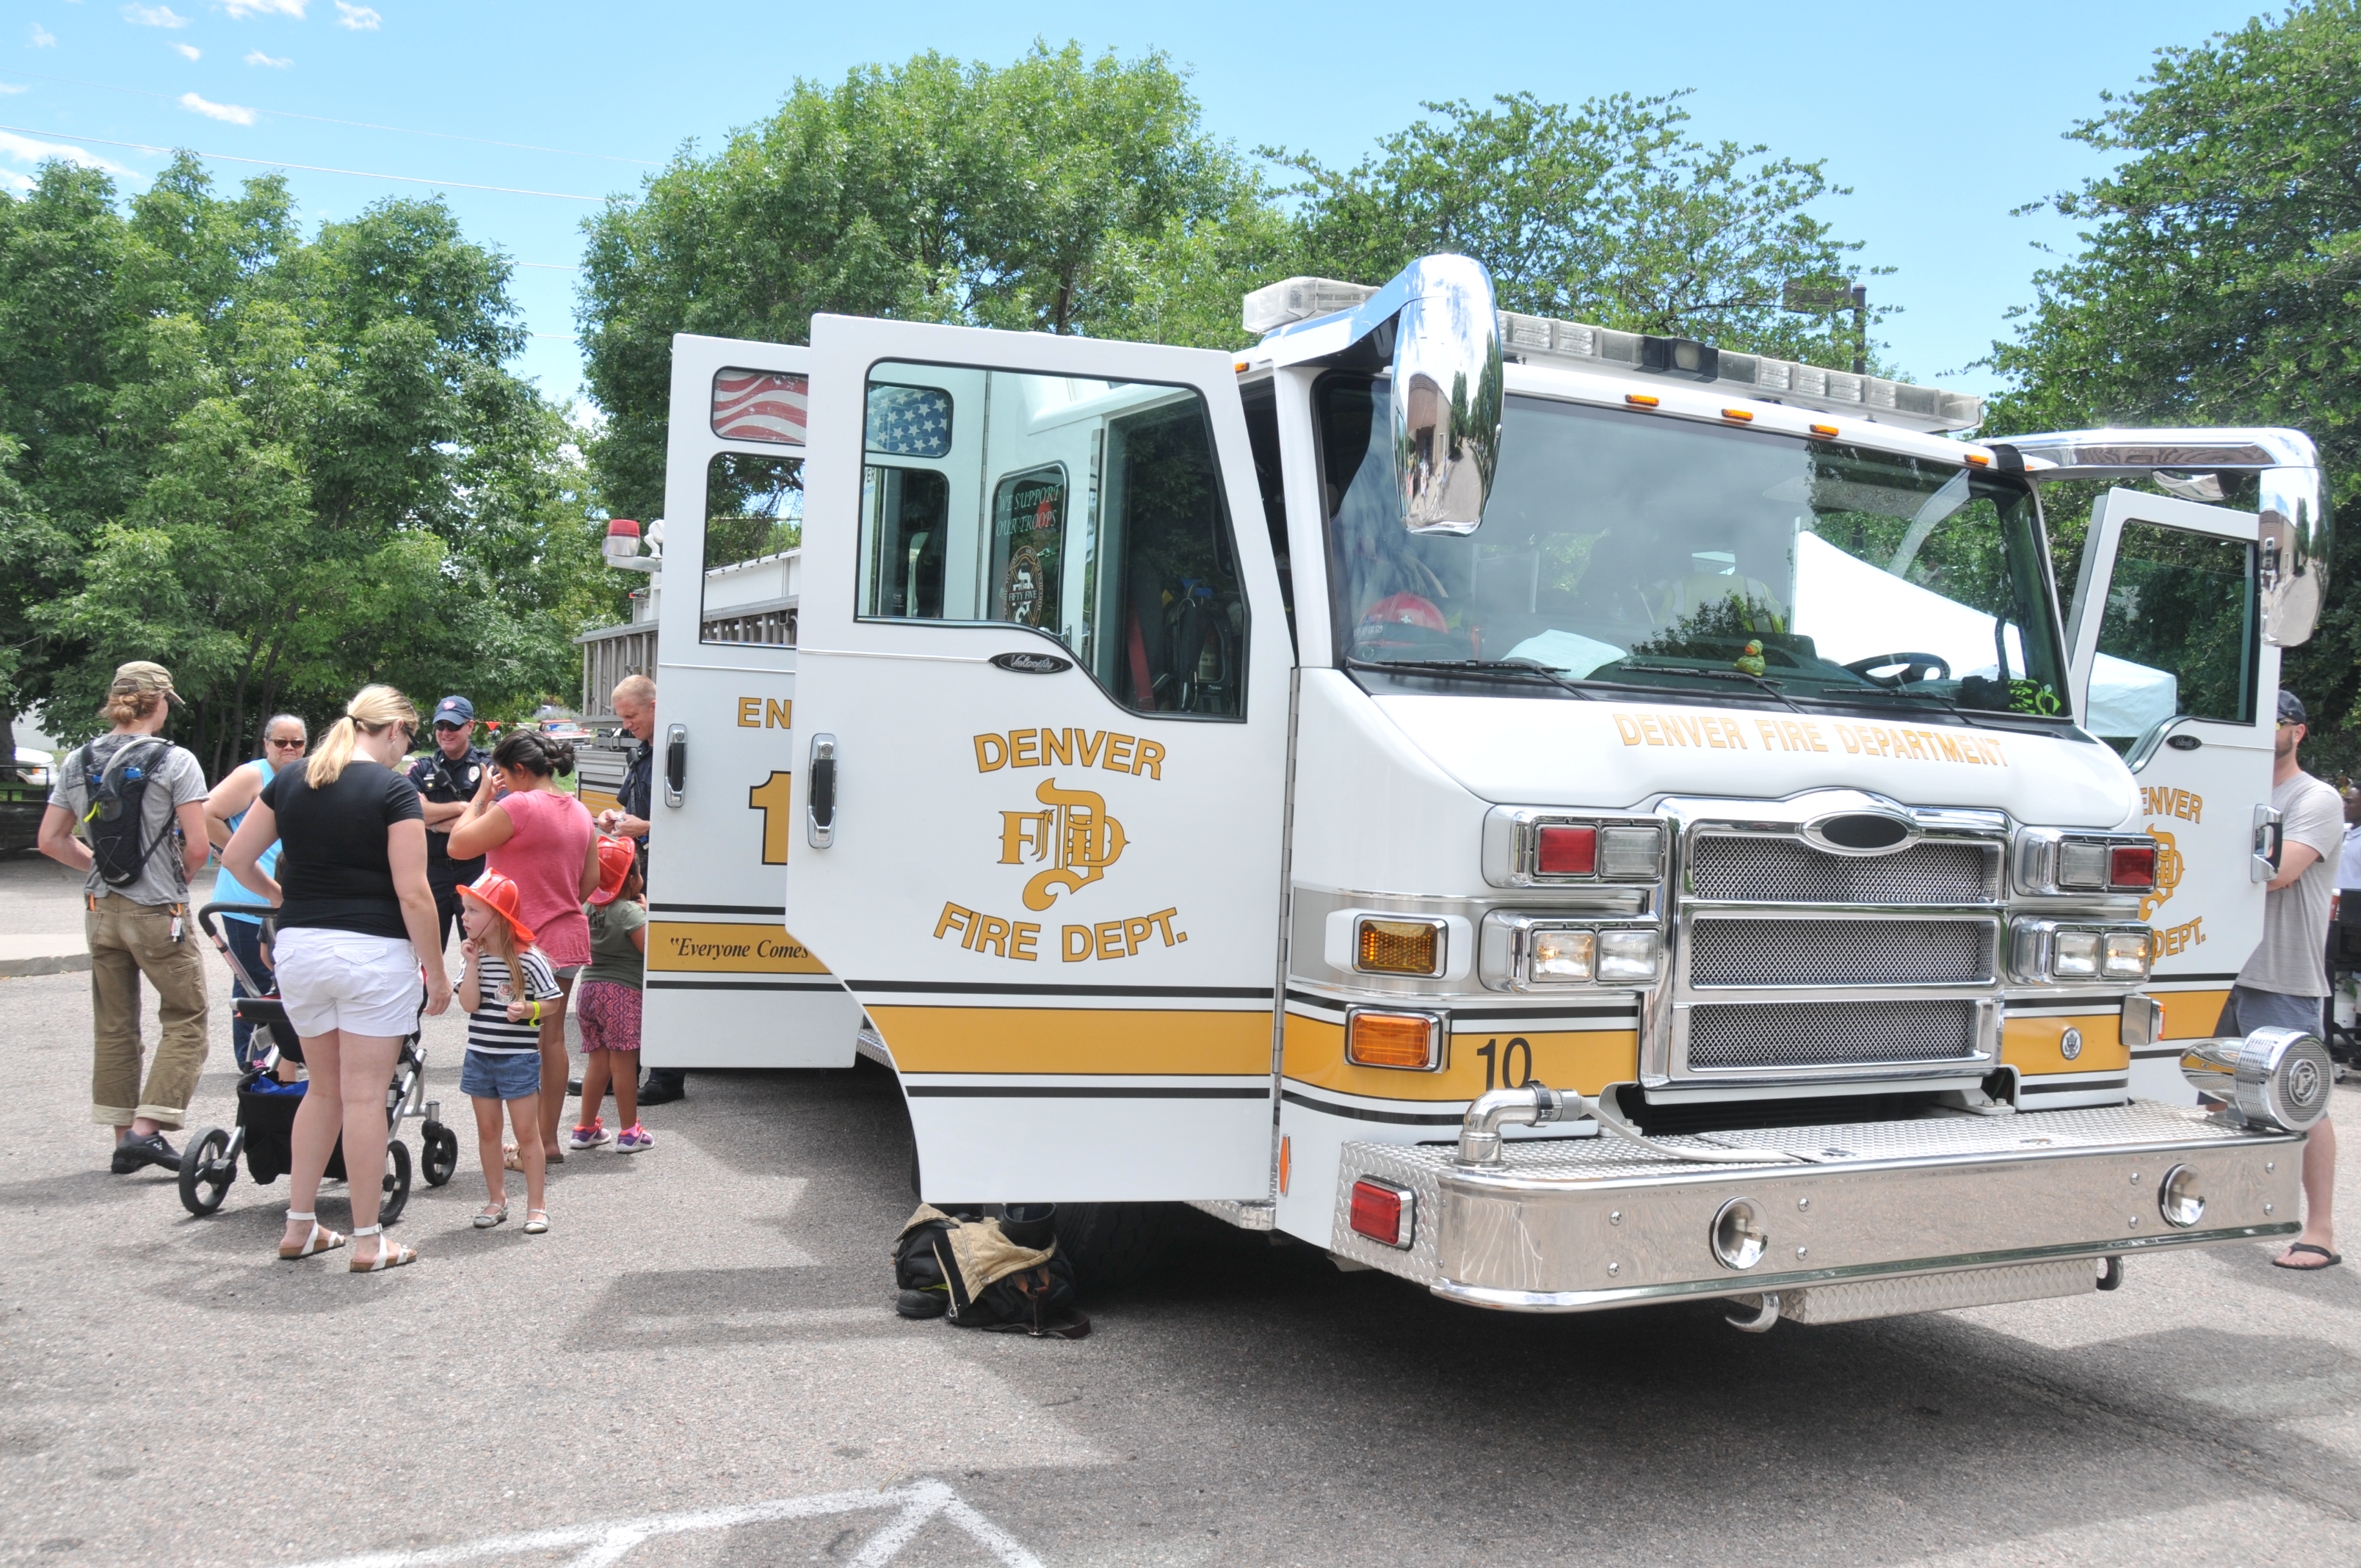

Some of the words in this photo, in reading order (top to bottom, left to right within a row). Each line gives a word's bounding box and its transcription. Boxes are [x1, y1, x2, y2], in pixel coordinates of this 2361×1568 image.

[998, 494, 1013, 512] WE
[1014, 482, 1062, 509] SUPPORT
[996, 518, 1017, 537] OUR
[1019, 509, 1057, 532] TROOPS
[1008, 592, 1024, 602] FIFTY
[1025, 589, 1037, 600] FIVE
[973, 727, 1166, 780] DENVER
[1613, 714, 1748, 749] DENVER
[1754, 719, 1829, 752] FIRE
[1834, 724, 2009, 767] DEPARTMENT
[670, 937, 750, 960] "Everyone
[757, 940, 808, 959] Comes
[933, 901, 1041, 962] FIRE
[1062, 907, 1188, 962] DEPT.
[1476, 1037, 1532, 1092] 10
